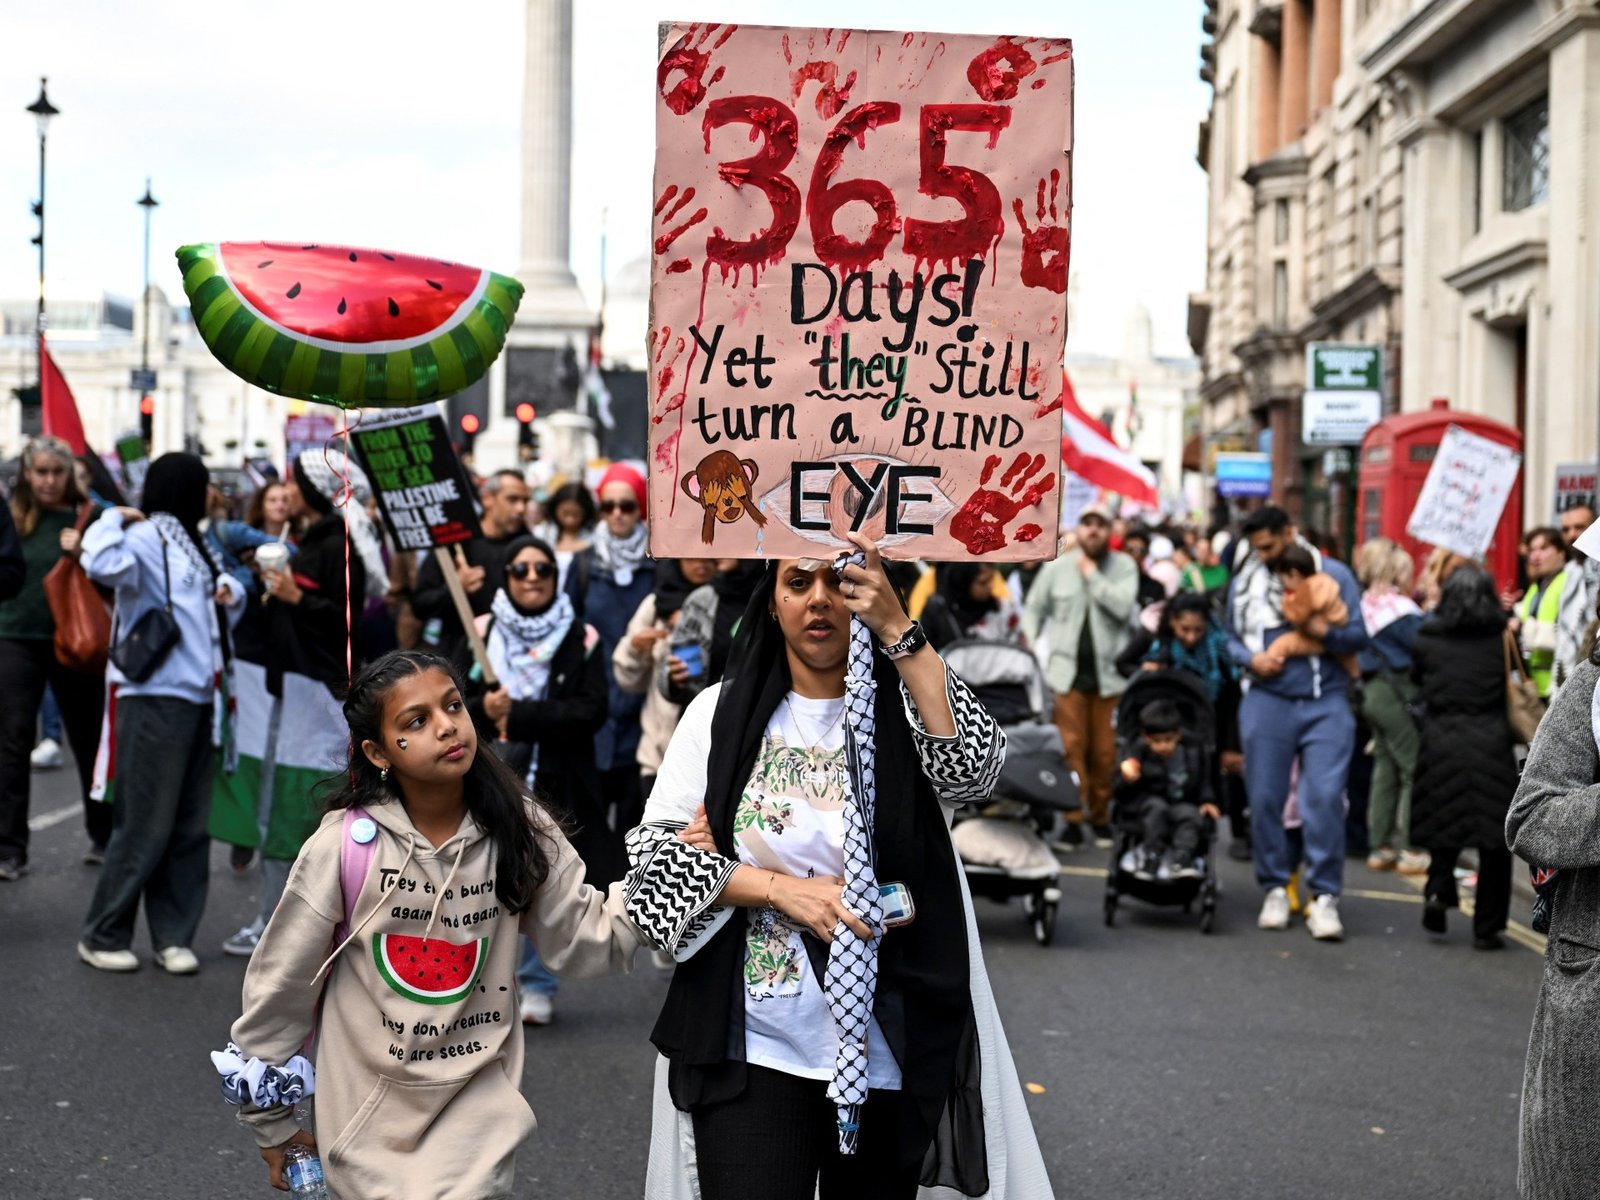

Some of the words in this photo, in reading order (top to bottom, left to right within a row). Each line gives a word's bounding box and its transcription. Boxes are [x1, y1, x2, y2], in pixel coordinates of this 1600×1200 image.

[702, 95, 1011, 266] 365
[790, 258, 985, 351] Days!
[689, 324, 776, 388] Yet
[692, 397, 797, 445] turn
[830, 412, 860, 444] a
[902, 407, 1024, 450] BLIND
[790, 461, 941, 535] EYE
[896, 636, 916, 652] LOVE
[461, 879, 494, 898] bury
[391, 906, 432, 921] again
[462, 905, 499, 926] again
[453, 1010, 501, 1031] realize
[411, 1049, 434, 1061] are
[440, 1040, 488, 1059] seeds.
